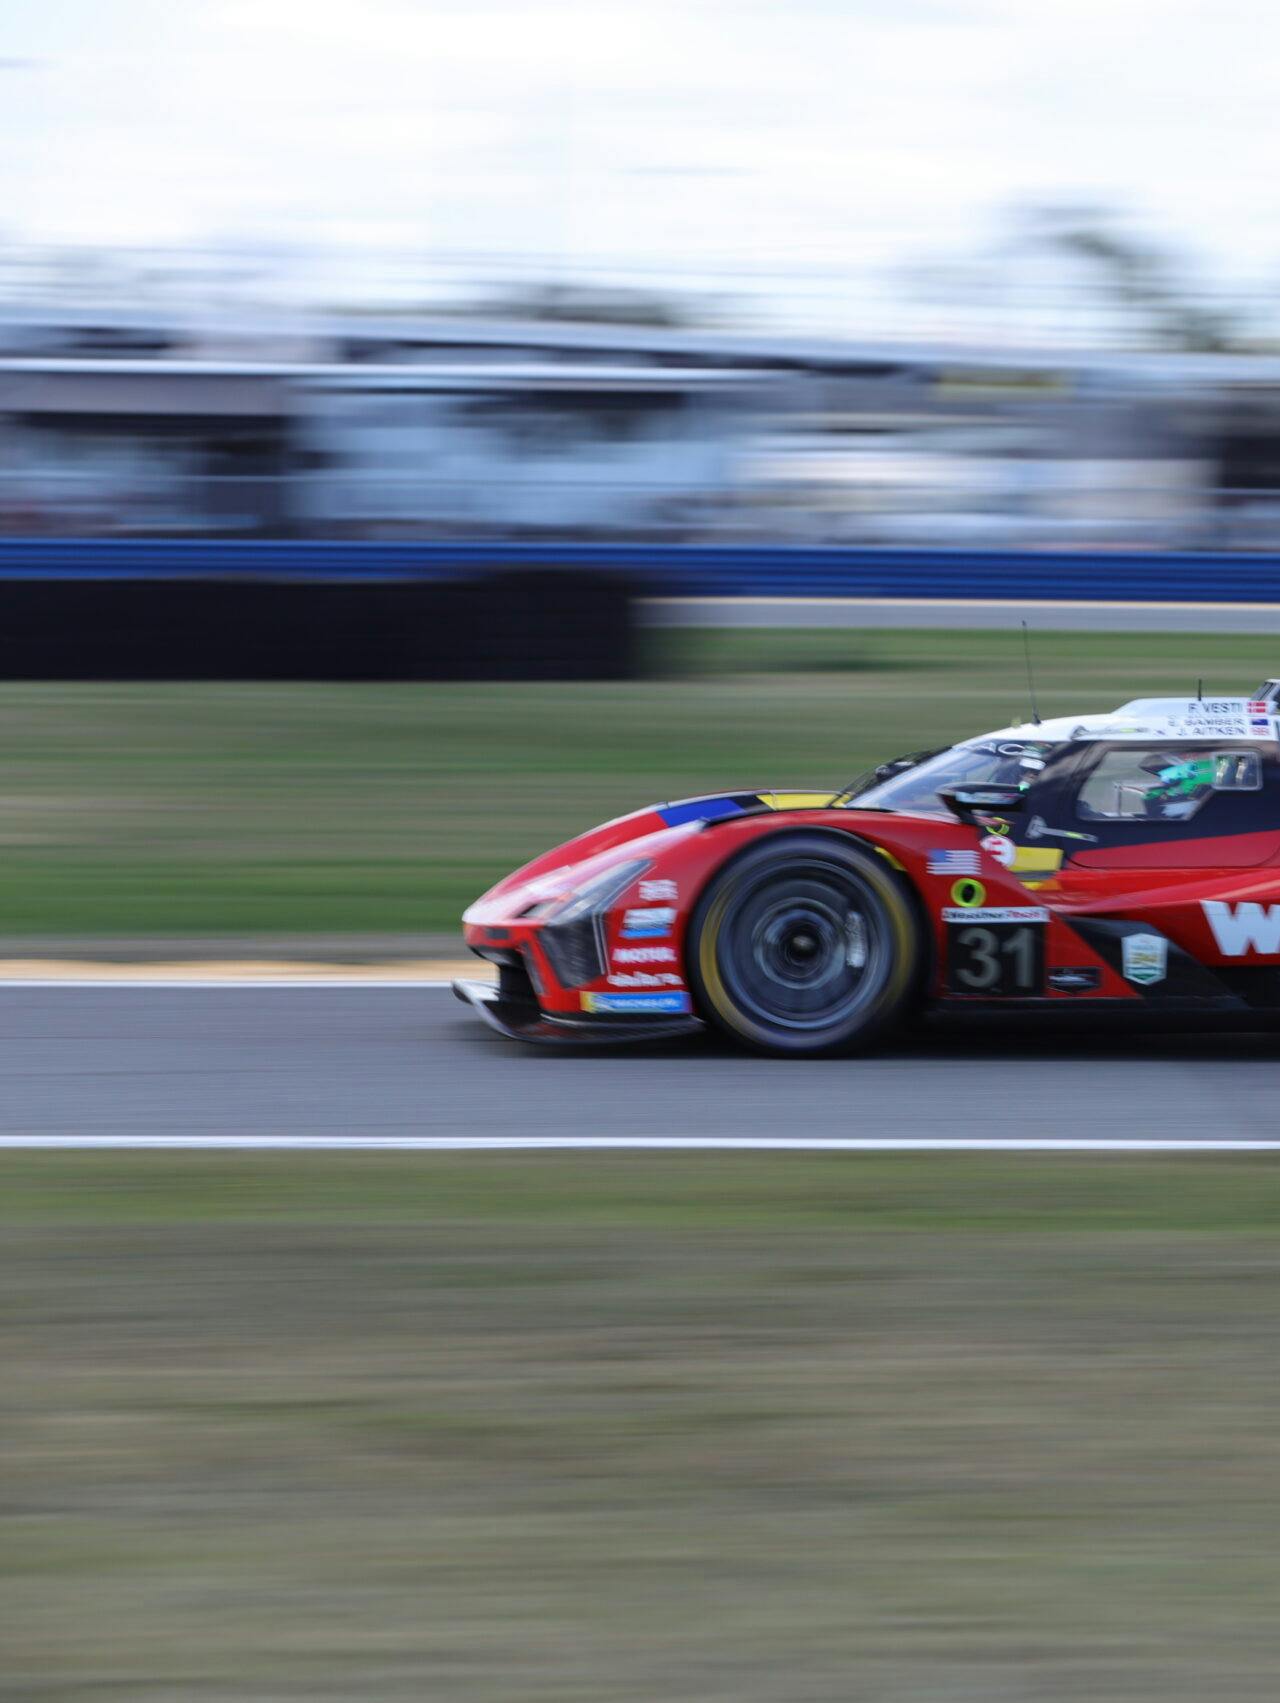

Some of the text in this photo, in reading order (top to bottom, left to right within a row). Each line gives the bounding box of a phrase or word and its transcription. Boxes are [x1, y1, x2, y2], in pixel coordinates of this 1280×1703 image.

[1201, 702, 1243, 713] VESTI
[1192, 727, 1246, 736] AITKEN
[957, 927, 1035, 988] 31
